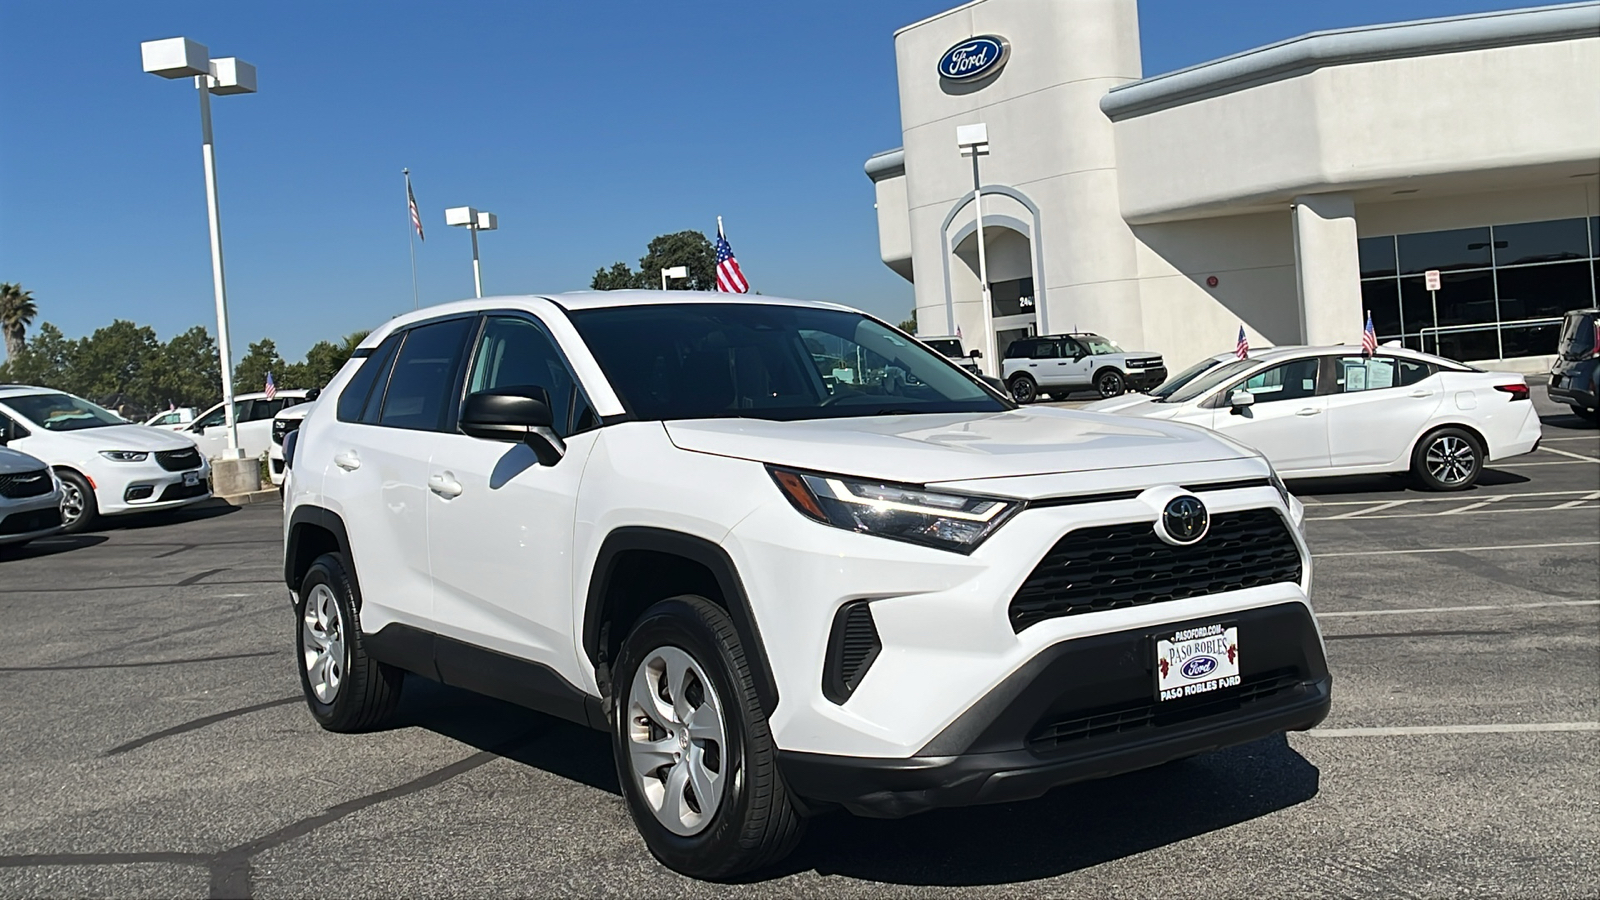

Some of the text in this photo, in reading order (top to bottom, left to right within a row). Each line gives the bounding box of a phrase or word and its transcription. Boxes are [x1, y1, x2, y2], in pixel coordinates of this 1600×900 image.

[949, 44, 988, 74] Ford
[1175, 624, 1222, 642] PASOFORD.COM
[1169, 637, 1228, 667] PASO ROBLES
[1187, 658, 1212, 676] Ford
[1160, 675, 1241, 702] PASO ROBLES FORD
